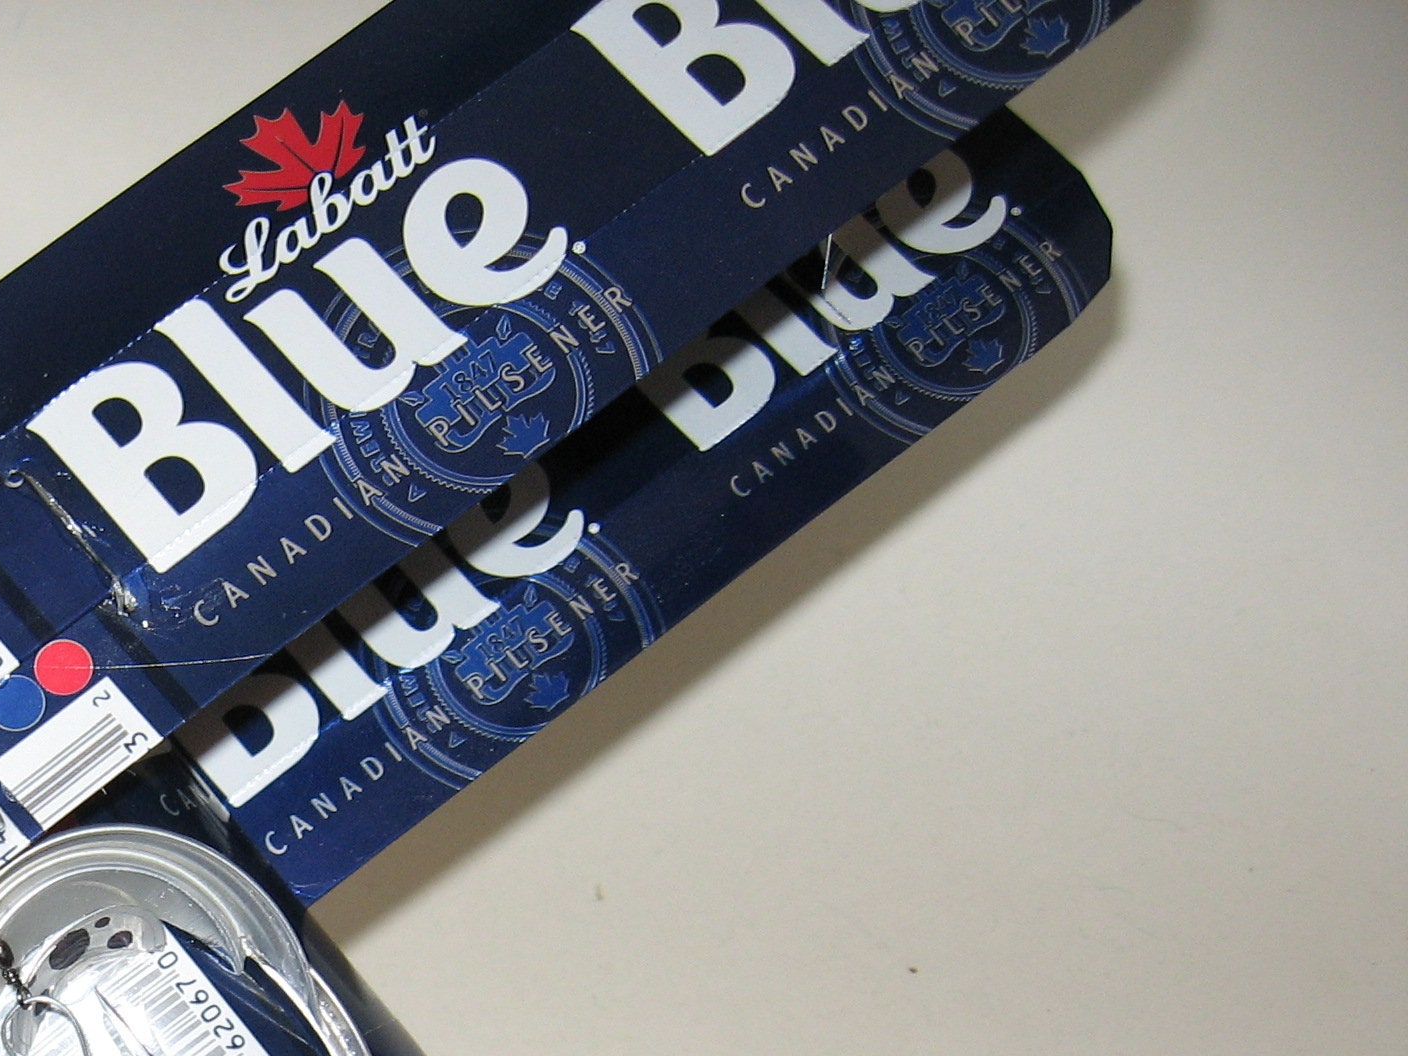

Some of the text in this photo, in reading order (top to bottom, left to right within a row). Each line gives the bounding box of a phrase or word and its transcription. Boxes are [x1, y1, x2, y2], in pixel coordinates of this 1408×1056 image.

[219, 115, 436, 302] Labatt
[739, 54, 941, 210] CANADIAN
[26, 157, 568, 574] Blue
[193, 453, 410, 627] CANADIAN
[432, 285, 632, 447] PILSENER
[729, 240, 1062, 498] CANADIAN PILSENER
[90, 688, 112, 708] 2
[264, 561, 640, 856] CANADIAN PILSENER
[155, 948, 180, 971] 0
[174, 970, 247, 1056] 62067
